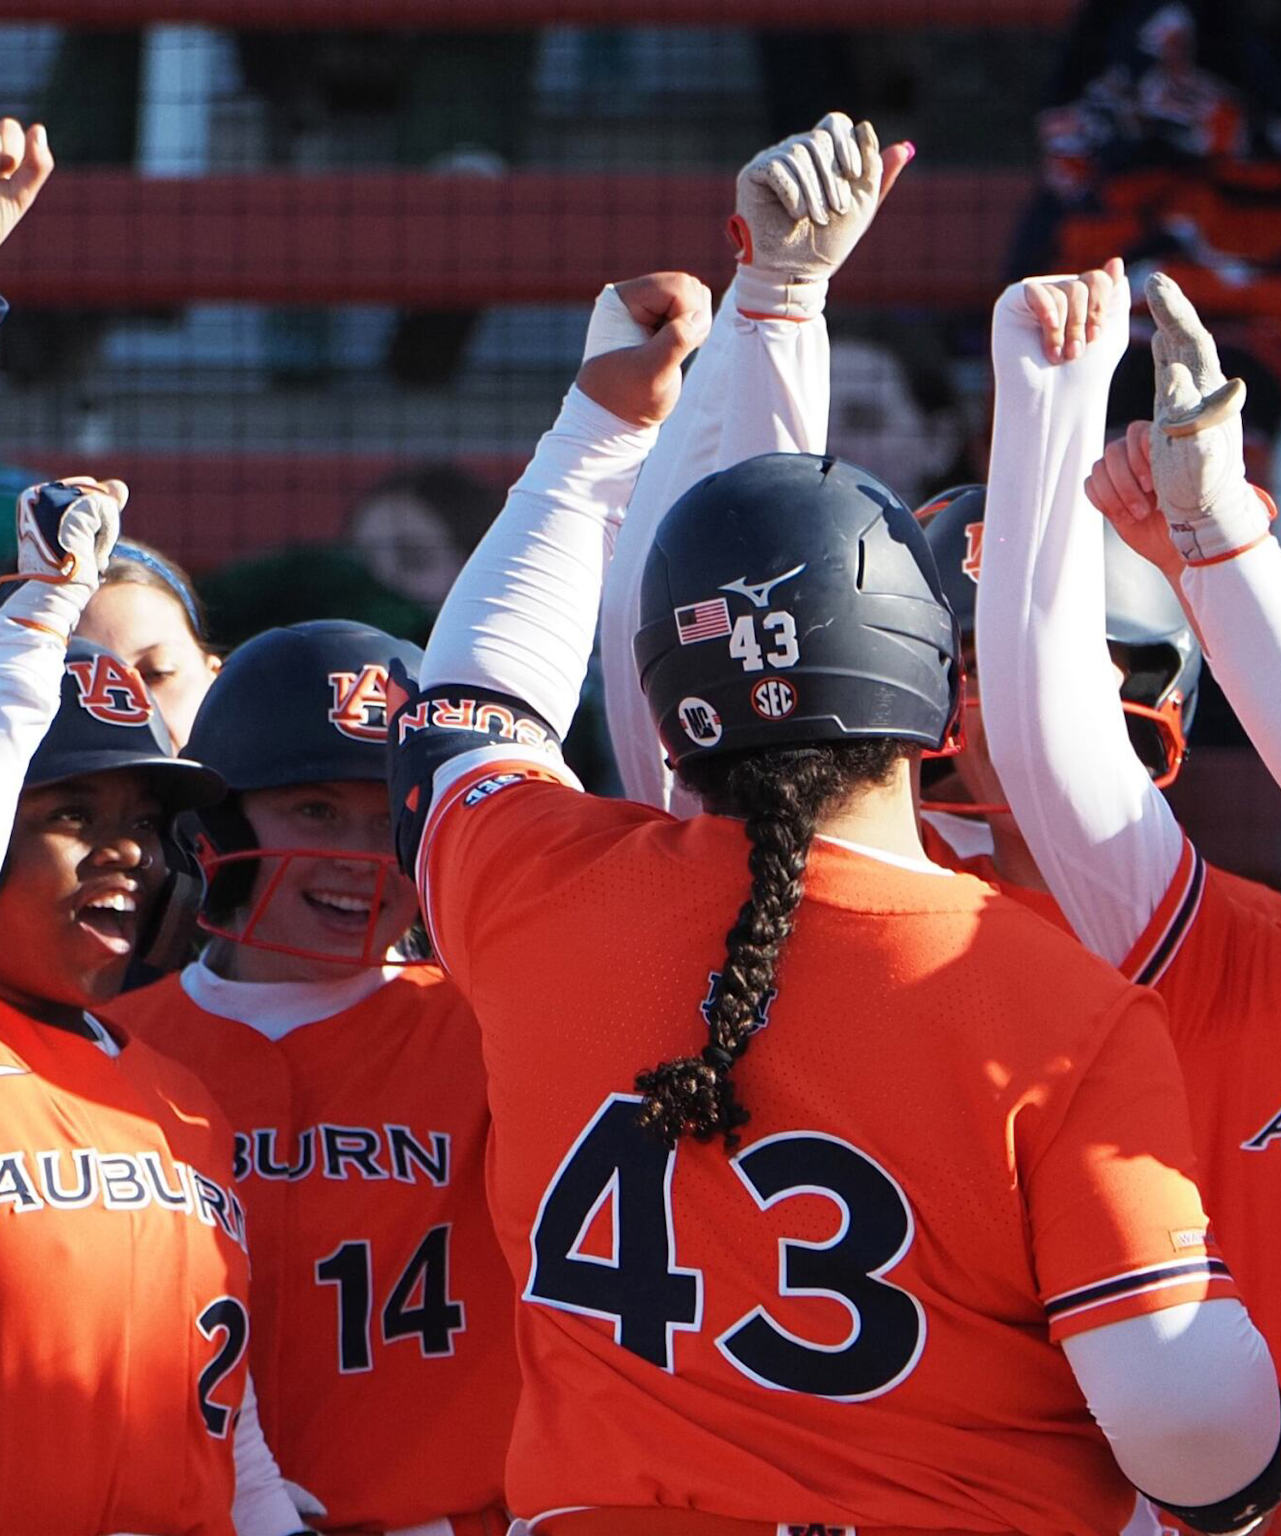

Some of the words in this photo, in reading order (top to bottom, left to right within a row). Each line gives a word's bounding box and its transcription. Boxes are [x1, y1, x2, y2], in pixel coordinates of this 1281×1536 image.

[729, 611, 800, 672] 43
[755, 680, 793, 717] SEC
[314, 1222, 467, 1375] 14
[522, 1092, 926, 1403] 43
[195, 1295, 250, 1439] 2
